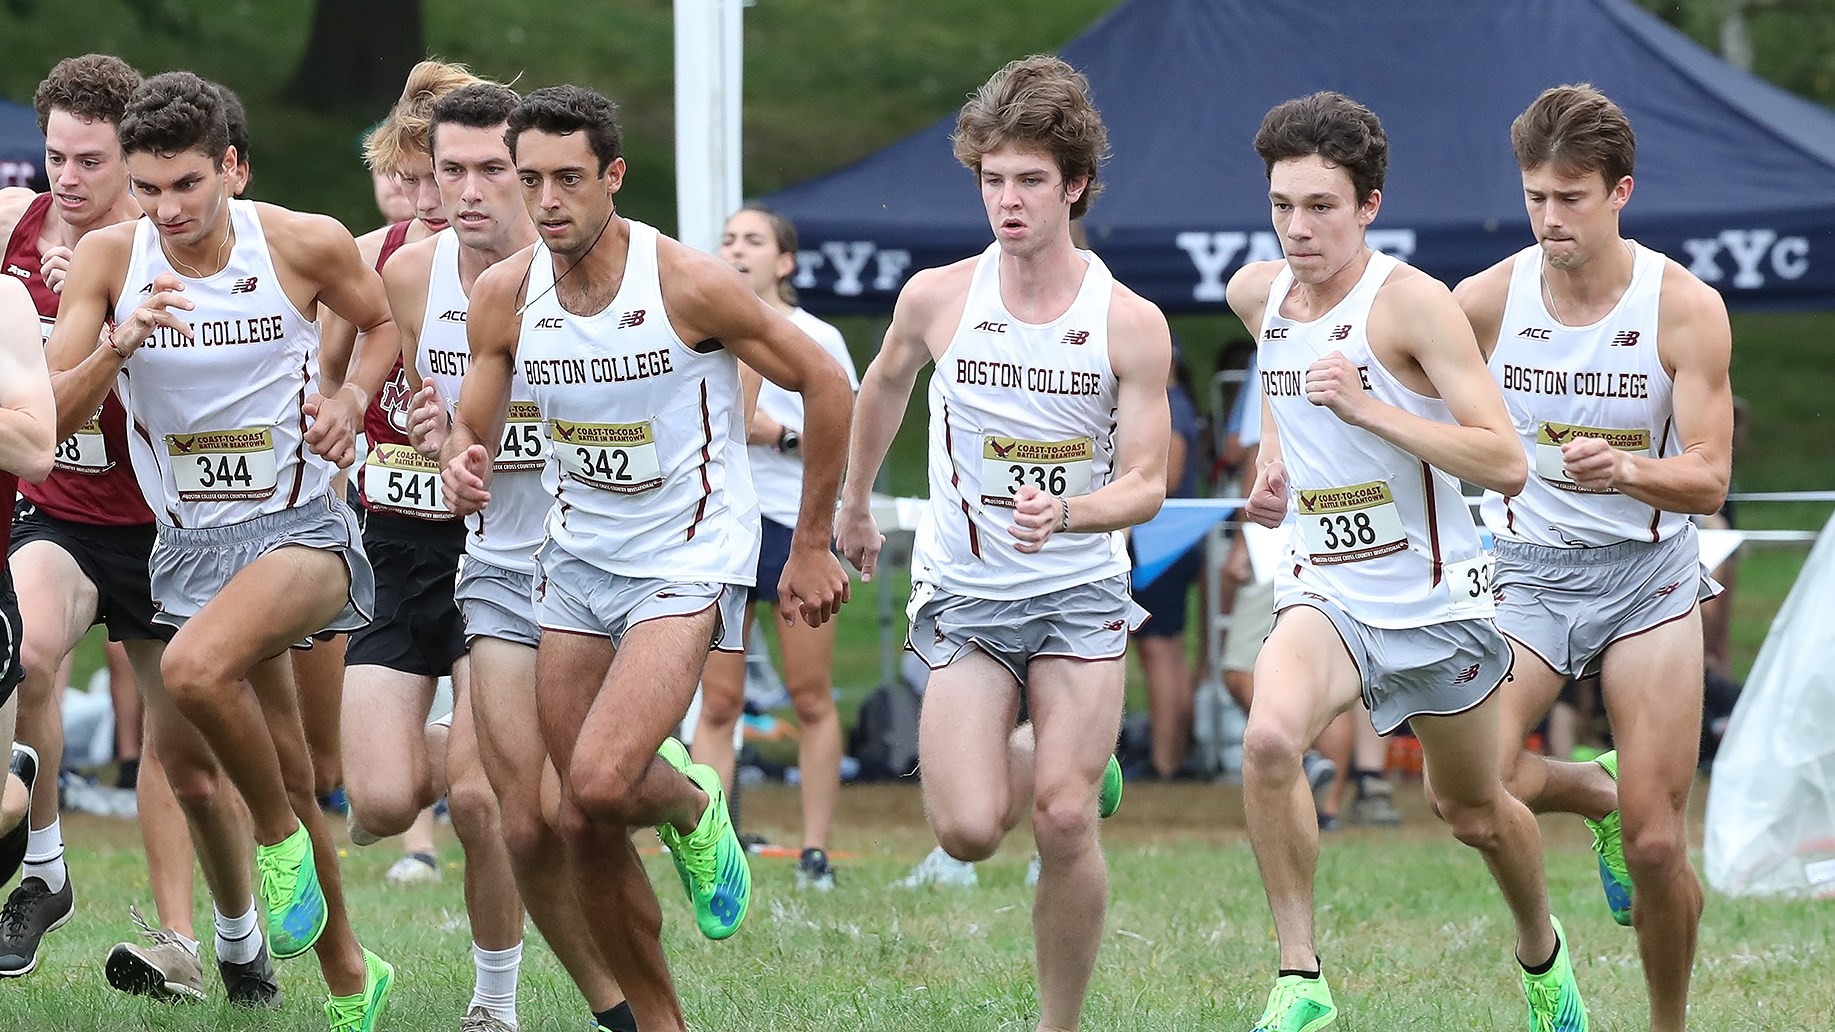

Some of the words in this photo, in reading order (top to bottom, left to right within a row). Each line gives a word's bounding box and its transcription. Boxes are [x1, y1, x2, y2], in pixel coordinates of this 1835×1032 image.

[439, 311, 467, 321] ACC
[534, 318, 564, 329] ACC
[139, 323, 195, 348] STON
[201, 315, 284, 346] COLLEGE
[974, 321, 1008, 333] ACC
[1262, 328, 1289, 339] ACC
[1518, 328, 1552, 340] ACC
[430, 349, 472, 377] BOST
[524, 359, 587, 385] BOSTON
[591, 349, 674, 383] COLLEGE
[956, 359, 1023, 389] BOSTON
[1027, 367, 1101, 396] COLLEGE
[1260, 370, 1301, 396] OSTON
[1504, 364, 1568, 395] BOSTON
[1574, 373, 1648, 399] COLLEGE
[197, 432, 264, 443] COAST-TO-COAST
[577, 426, 643, 436] COAST-TO-COAST
[610, 434, 645, 442] BEANTOWN
[230, 440, 265, 448] BEANTOWN
[496, 425, 541, 457] 45
[1017, 442, 1086, 454] COAST-TO-COAST
[395, 458, 413, 466] BATTLE
[1016, 451, 1039, 459] BATTLE
[1051, 450, 1086, 459] BEANTOWN
[196, 455, 252, 487] 344
[576, 447, 632, 480] 342
[1007, 464, 1067, 496] 336
[387, 471, 436, 507] 541
[1318, 486, 1381, 502] COAST-TO-COAST
[1320, 500, 1339, 509] BATTLE
[1349, 493, 1384, 506] BEANTOWN
[1319, 512, 1376, 549] 338
[1467, 564, 1490, 598] 33
